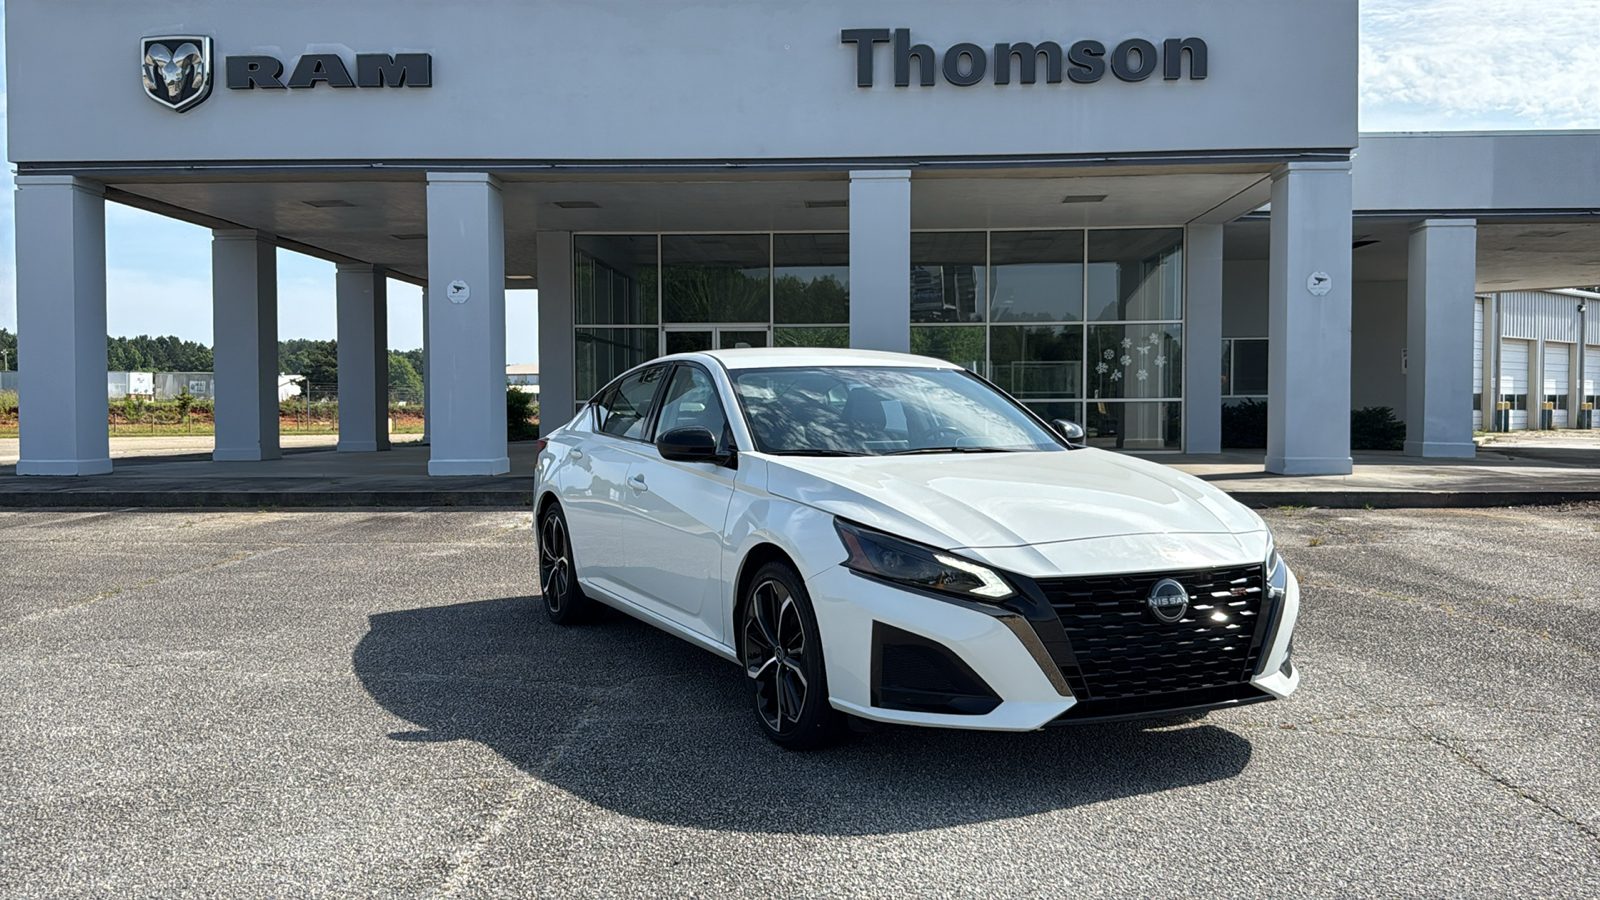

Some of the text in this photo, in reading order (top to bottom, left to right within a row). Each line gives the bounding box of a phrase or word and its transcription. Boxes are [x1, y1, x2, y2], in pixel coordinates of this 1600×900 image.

[226, 53, 432, 89] RAM
[841, 28, 1208, 88] Thomson
[1149, 596, 1189, 606] NISSAN
